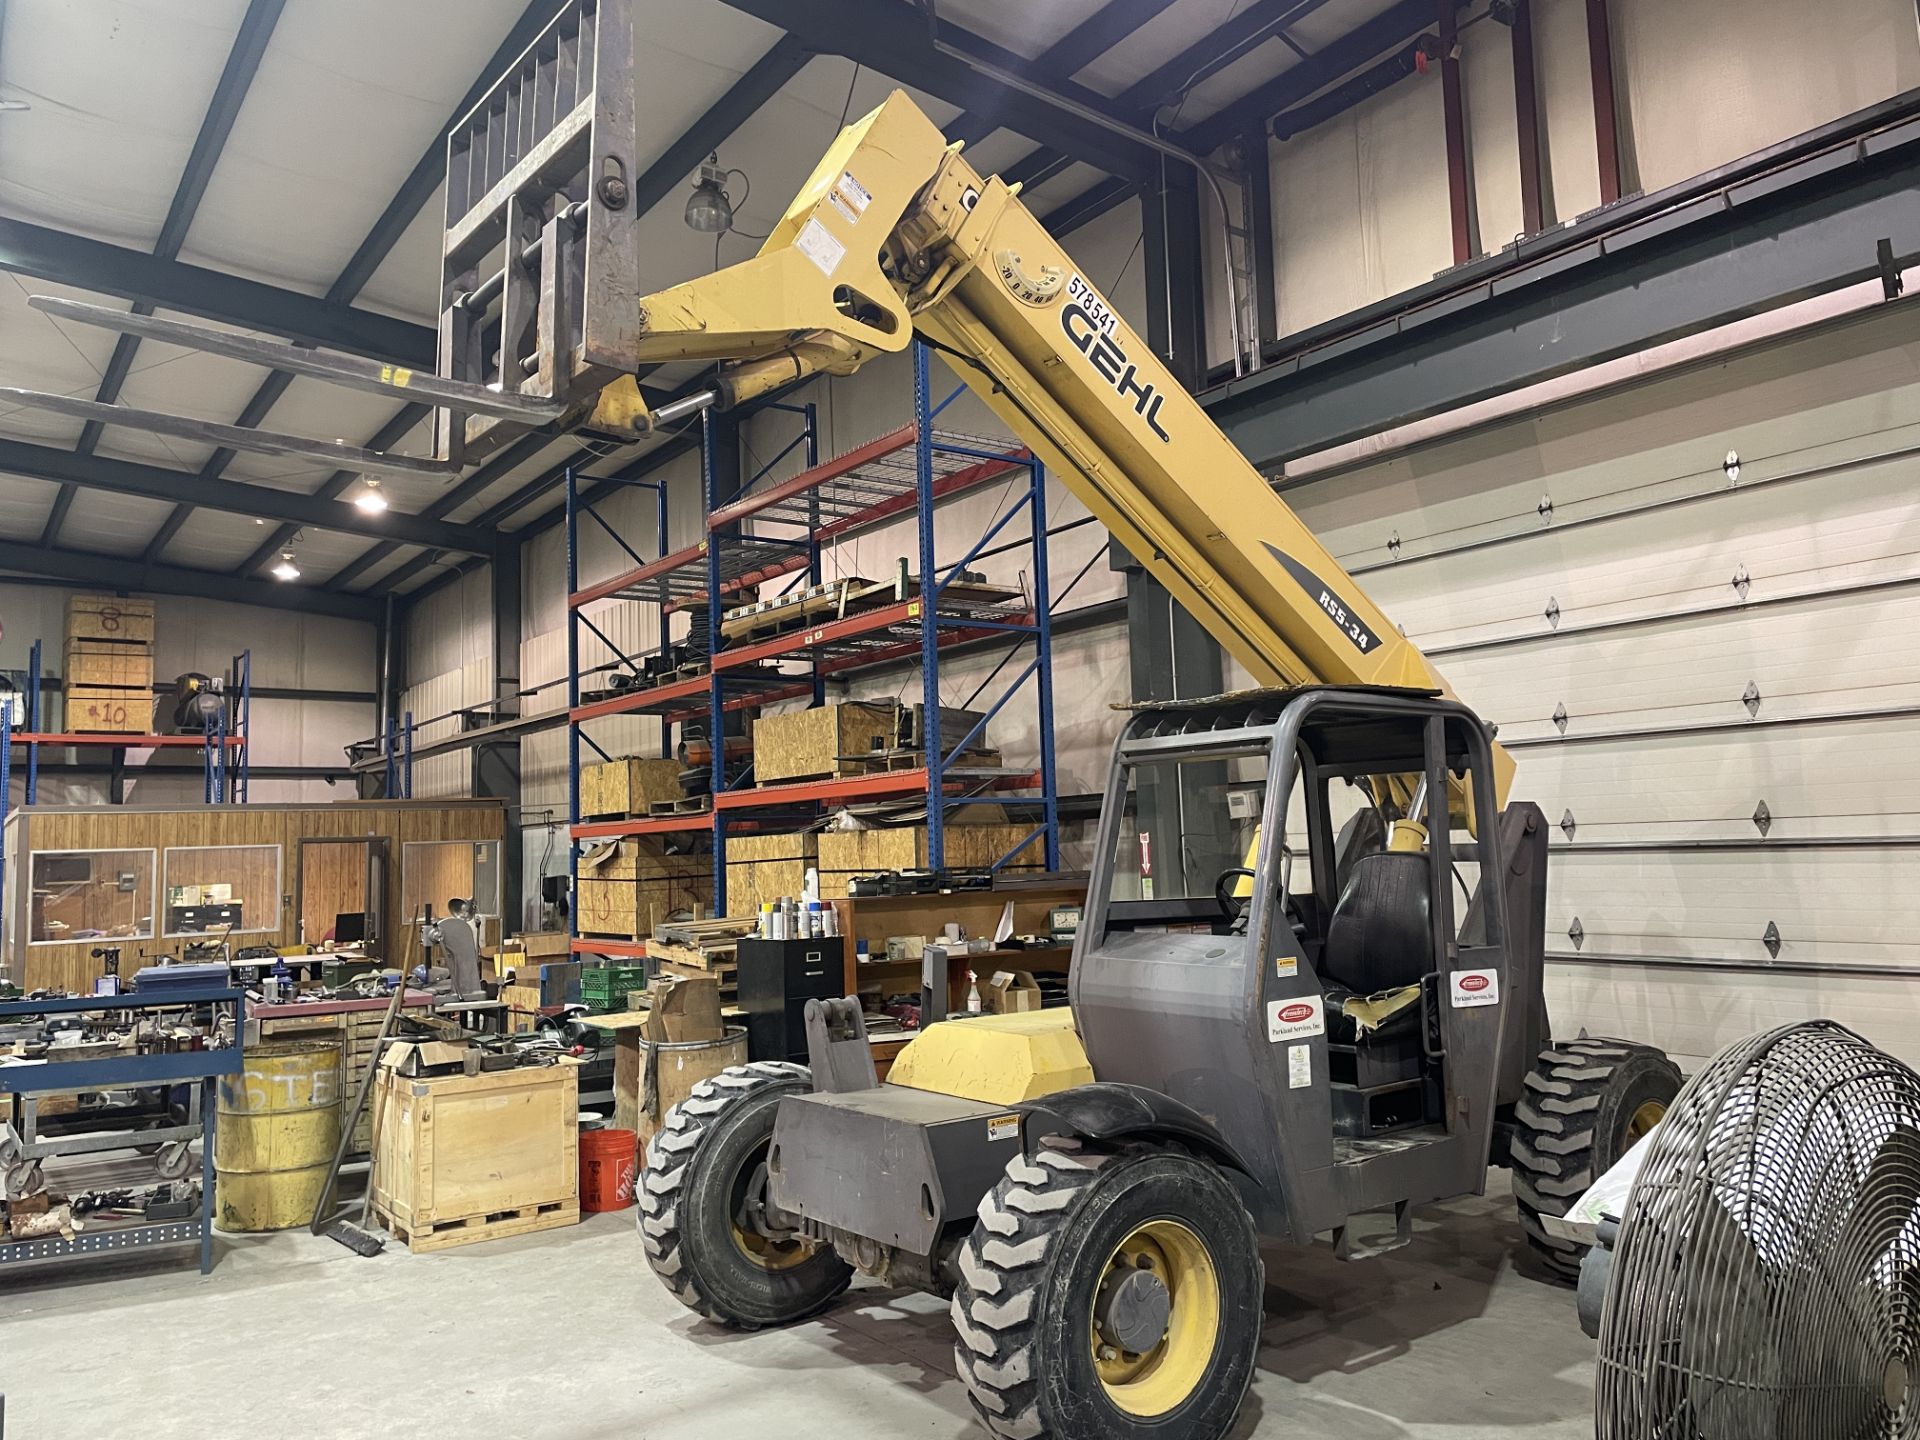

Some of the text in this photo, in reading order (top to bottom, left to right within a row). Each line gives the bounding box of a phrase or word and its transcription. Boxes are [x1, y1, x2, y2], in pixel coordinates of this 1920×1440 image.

[1002, 265, 1012, 279] -20
[1022, 291, 1033, 300] 20
[1069, 276, 1116, 335] 578541
[1061, 303, 1170, 443] GEHL
[101, 606, 122, 632] 8
[1319, 591, 1368, 649] RS5-34
[1272, 1025, 1293, 1036] Parkland
